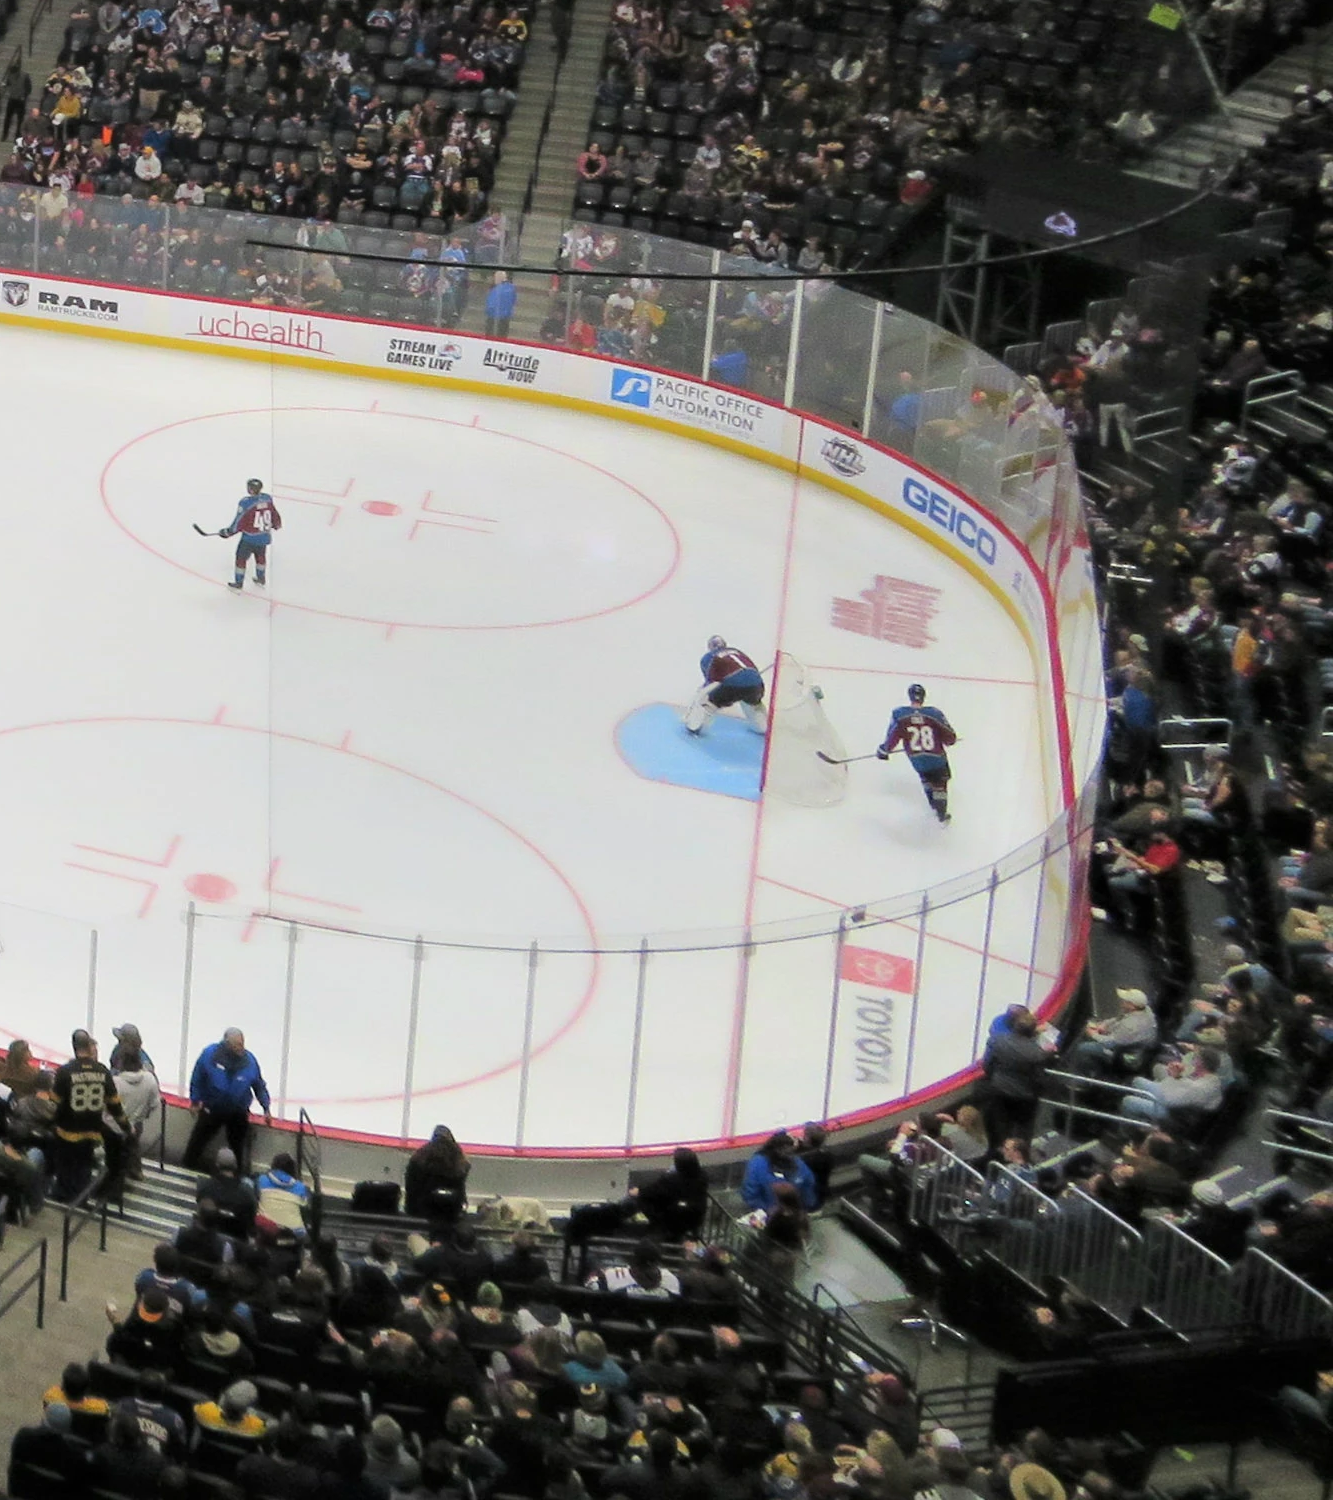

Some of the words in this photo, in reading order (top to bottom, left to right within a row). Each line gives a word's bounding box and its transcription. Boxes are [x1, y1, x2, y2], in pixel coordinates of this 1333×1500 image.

[37, 304, 119, 322] RAMTRUCKS.COM
[38, 291, 119, 314] RAM
[197, 311, 324, 351] uchealth
[389, 338, 436, 356] STREAM
[484, 348, 540, 371] Altitude
[386, 352, 426, 368] GAMES
[428, 357, 454, 372] LIVE
[656, 377, 710, 402] PACIFIC
[714, 394, 765, 420] OFFICE
[654, 393, 755, 432] AUTOMATION
[253, 509, 272, 532] 49
[902, 476, 998, 566] GEICO
[906, 725, 936, 752] 28
[854, 995, 895, 1084] TOYOTA
[70, 1082, 106, 1112] 88
